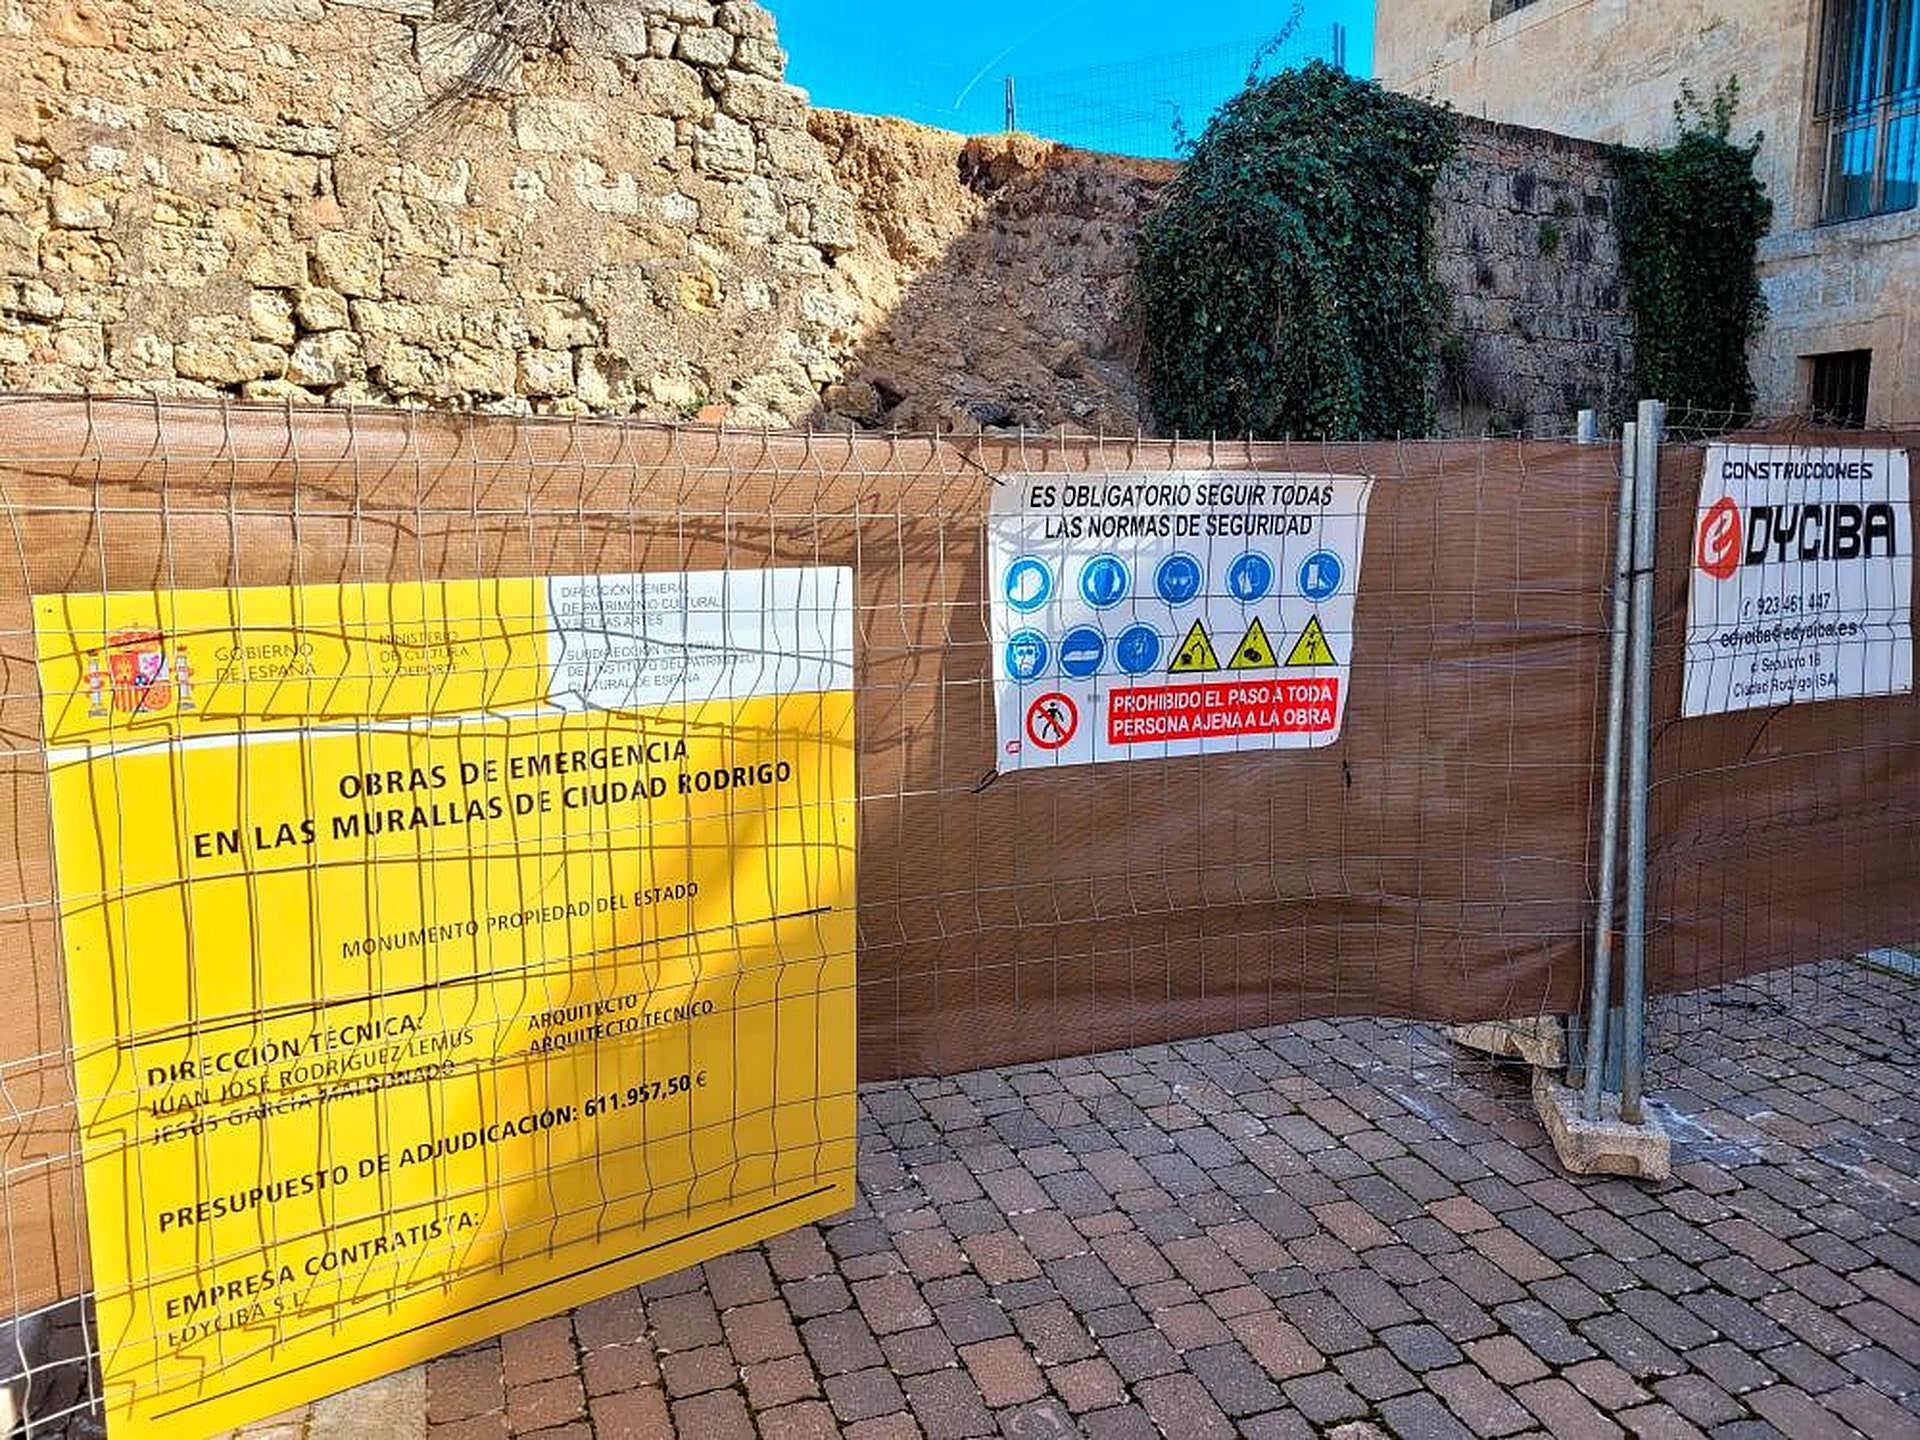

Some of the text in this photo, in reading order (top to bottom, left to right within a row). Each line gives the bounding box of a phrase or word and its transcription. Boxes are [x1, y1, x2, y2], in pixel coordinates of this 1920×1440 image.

[1722, 462, 1873, 480] CONSTRUCCIONES
[1031, 484, 1333, 508] ES OBLIGATORIO SEGUIR TODAS
[1045, 512, 1313, 540] LAS NORMAS DE SEGURIDAD
[635, 582, 688, 597] GENERA
[214, 642, 314, 662] GOBIERNO
[216, 667, 240, 682] DE
[1113, 686, 1333, 714] PROHIBIDO EL PASO A TODA
[1112, 708, 1333, 738] PERSONA AJENA A LA OBRA
[339, 739, 690, 800] OBRAS DE EMERGENCIA
[194, 760, 792, 859] EN LAS MURALLAS DE CIUDAD RODRIGO
[341, 881, 700, 959] MONUMENTO PROPIEDAD DEL ESTADO
[528, 993, 638, 1032] ARQUITECTO
[529, 1015, 638, 1053] ARQUITECTO
[148, 1038, 302, 1088] DIRECCIÓN
[151, 1085, 211, 1117] JUAN
[408, 1026, 475, 1059] LEMUS
[158, 1164, 349, 1234] PRESUPUESTO
[358, 1153, 391, 1182] DE
[398, 1101, 578, 1169] ADJUDICACIÓN:
[583, 1071, 692, 1119] 611.957,50
[165, 1211, 481, 1321] EMPRESA CONTRATISTA:
[167, 1302, 266, 1349] EDYCIBA
